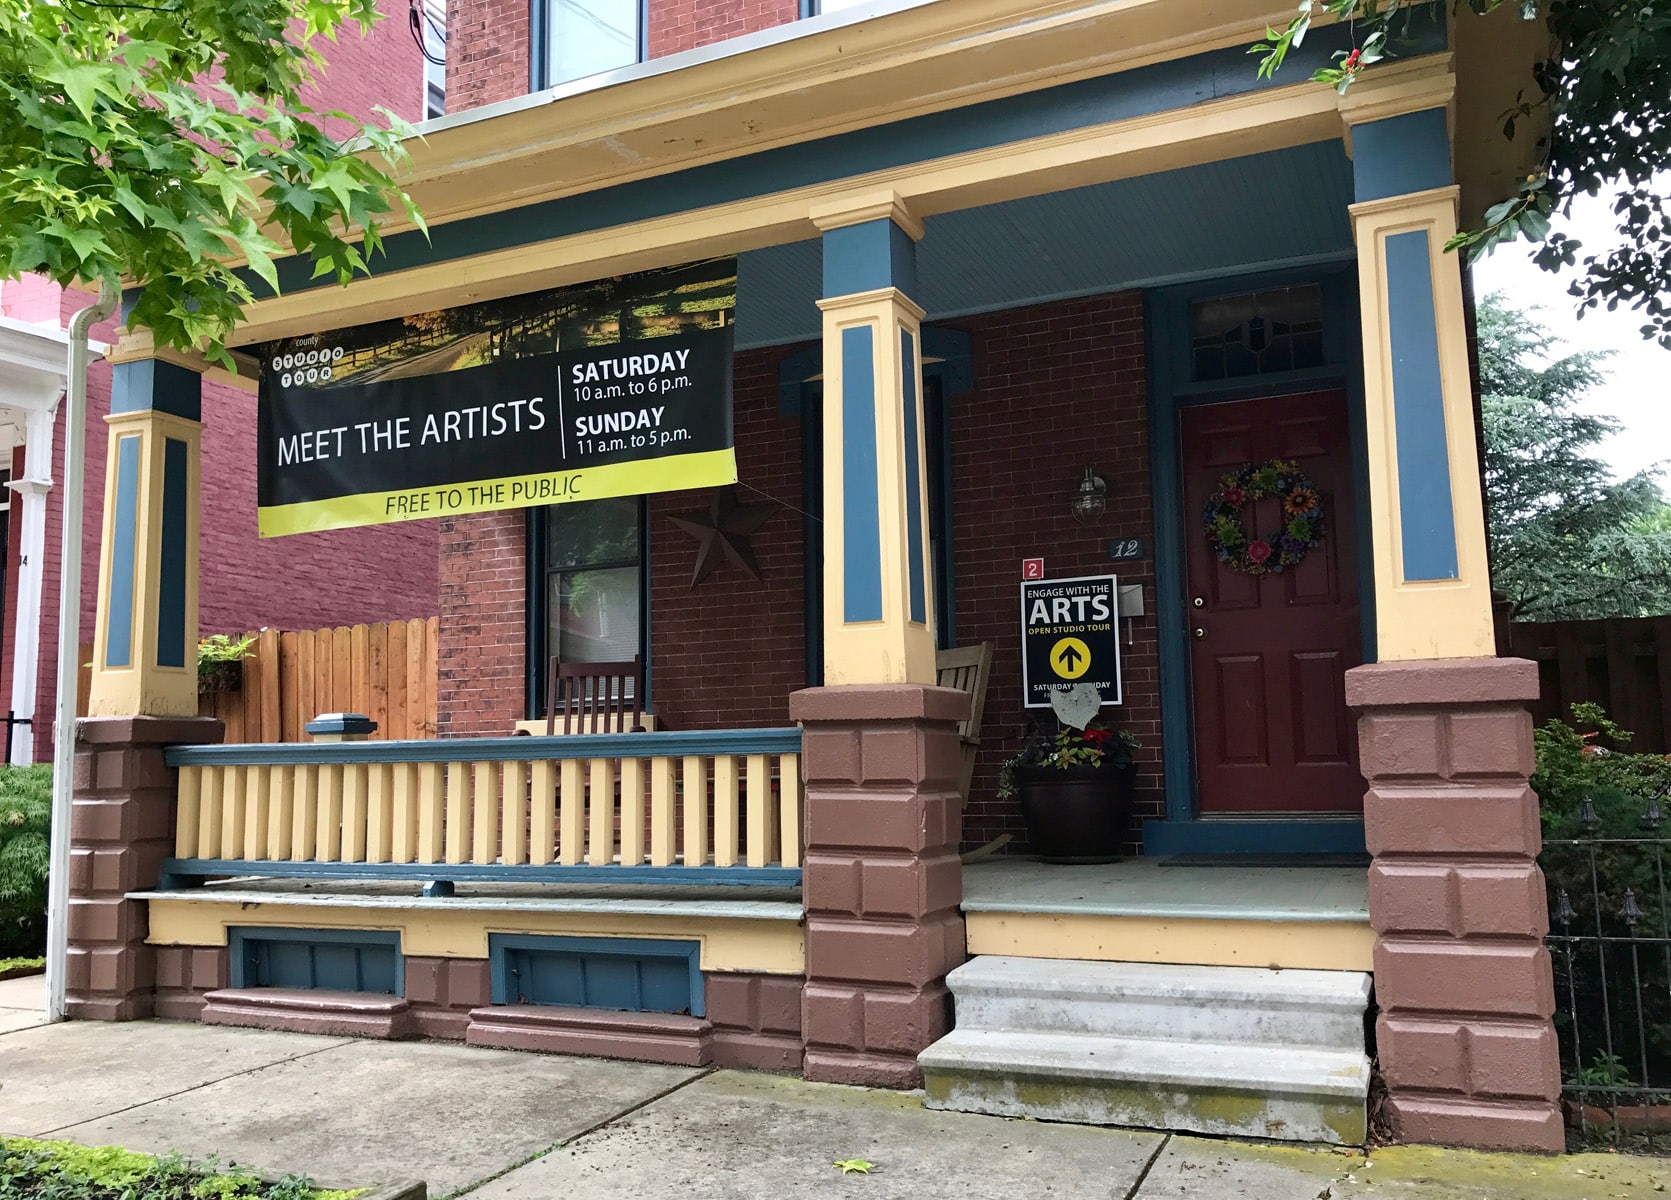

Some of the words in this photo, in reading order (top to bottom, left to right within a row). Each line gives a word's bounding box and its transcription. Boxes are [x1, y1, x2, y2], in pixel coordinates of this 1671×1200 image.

[296, 336, 319, 347] county
[273, 348, 342, 367] STUDIO
[572, 349, 690, 384] SATURDAY
[283, 368, 330, 386] TOUR
[574, 386, 591, 402] 10
[594, 384, 625, 400] a.m.
[628, 381, 645, 396] to
[648, 377, 658, 393] 6
[661, 375, 692, 395] p.m.
[575, 406, 665, 437] SUNDAY
[278, 427, 348, 467] MEET
[354, 417, 411, 454] THE
[420, 397, 546, 446] ARTISTS
[578, 440, 593, 455] 11
[598, 437, 627, 453] a.m.
[630, 433, 646, 448] to
[649, 430, 657, 445] 5
[660, 428, 692, 447] p.m.
[385, 493, 430, 515] FREE
[436, 489, 462, 510] TO
[467, 484, 504, 506] THE
[511, 474, 582, 501] PUBLIC
[1111, 540, 1138, 558] 12
[1028, 563, 1038, 577] 2
[1027, 588, 1064, 599] ENGAGE
[1066, 586, 1089, 596] WITH
[1091, 584, 1109, 594] THE
[1029, 594, 1110, 625] ARTS
[1028, 627, 1051, 636] OPEN
[1053, 625, 1085, 634] STUDIO
[1087, 623, 1111, 632] TOUR
[1033, 682, 1072, 691] SATURDAY
